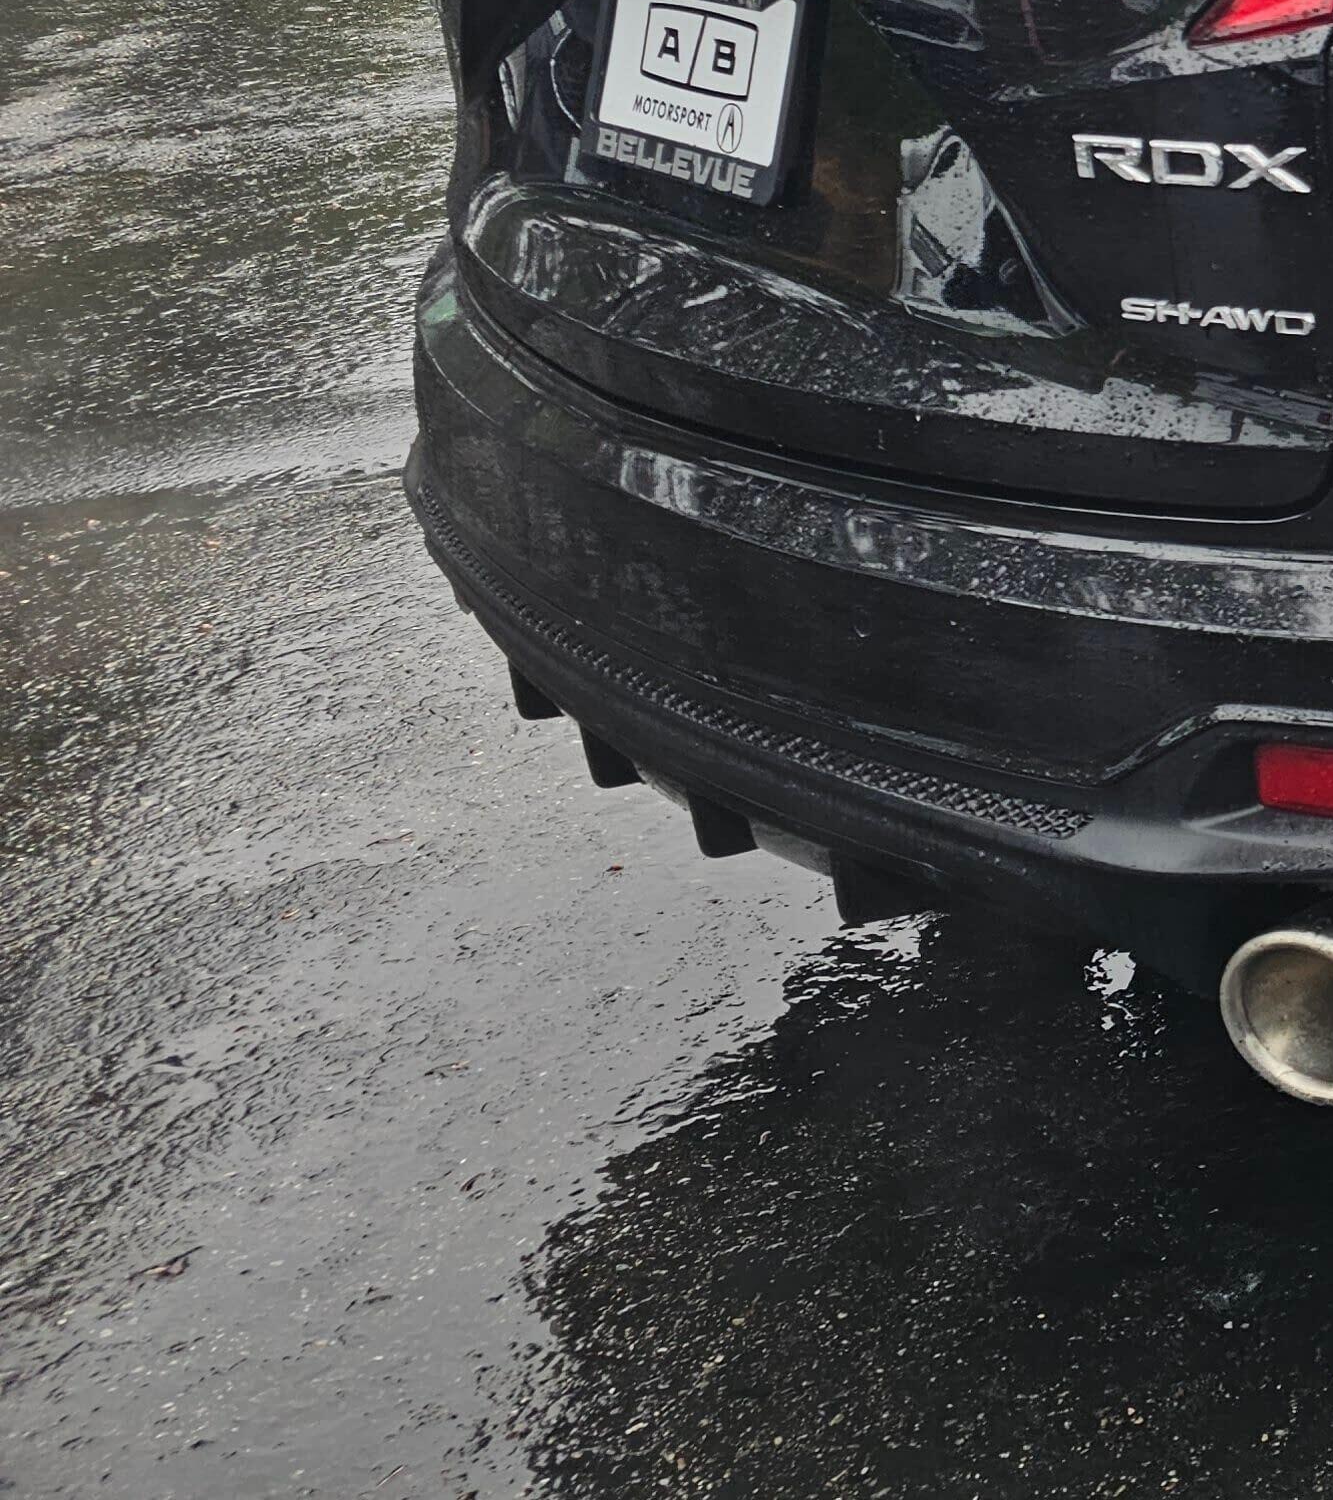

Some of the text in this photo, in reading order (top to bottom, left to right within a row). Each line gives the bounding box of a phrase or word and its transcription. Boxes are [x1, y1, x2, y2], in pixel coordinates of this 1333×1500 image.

[657, 26, 737, 76] A B
[632, 94, 713, 132] MOTORSPORT
[596, 126, 757, 199] BELLEVUE
[1071, 133, 1312, 194] RDX
[1120, 297, 1316, 337] SH-AWD
